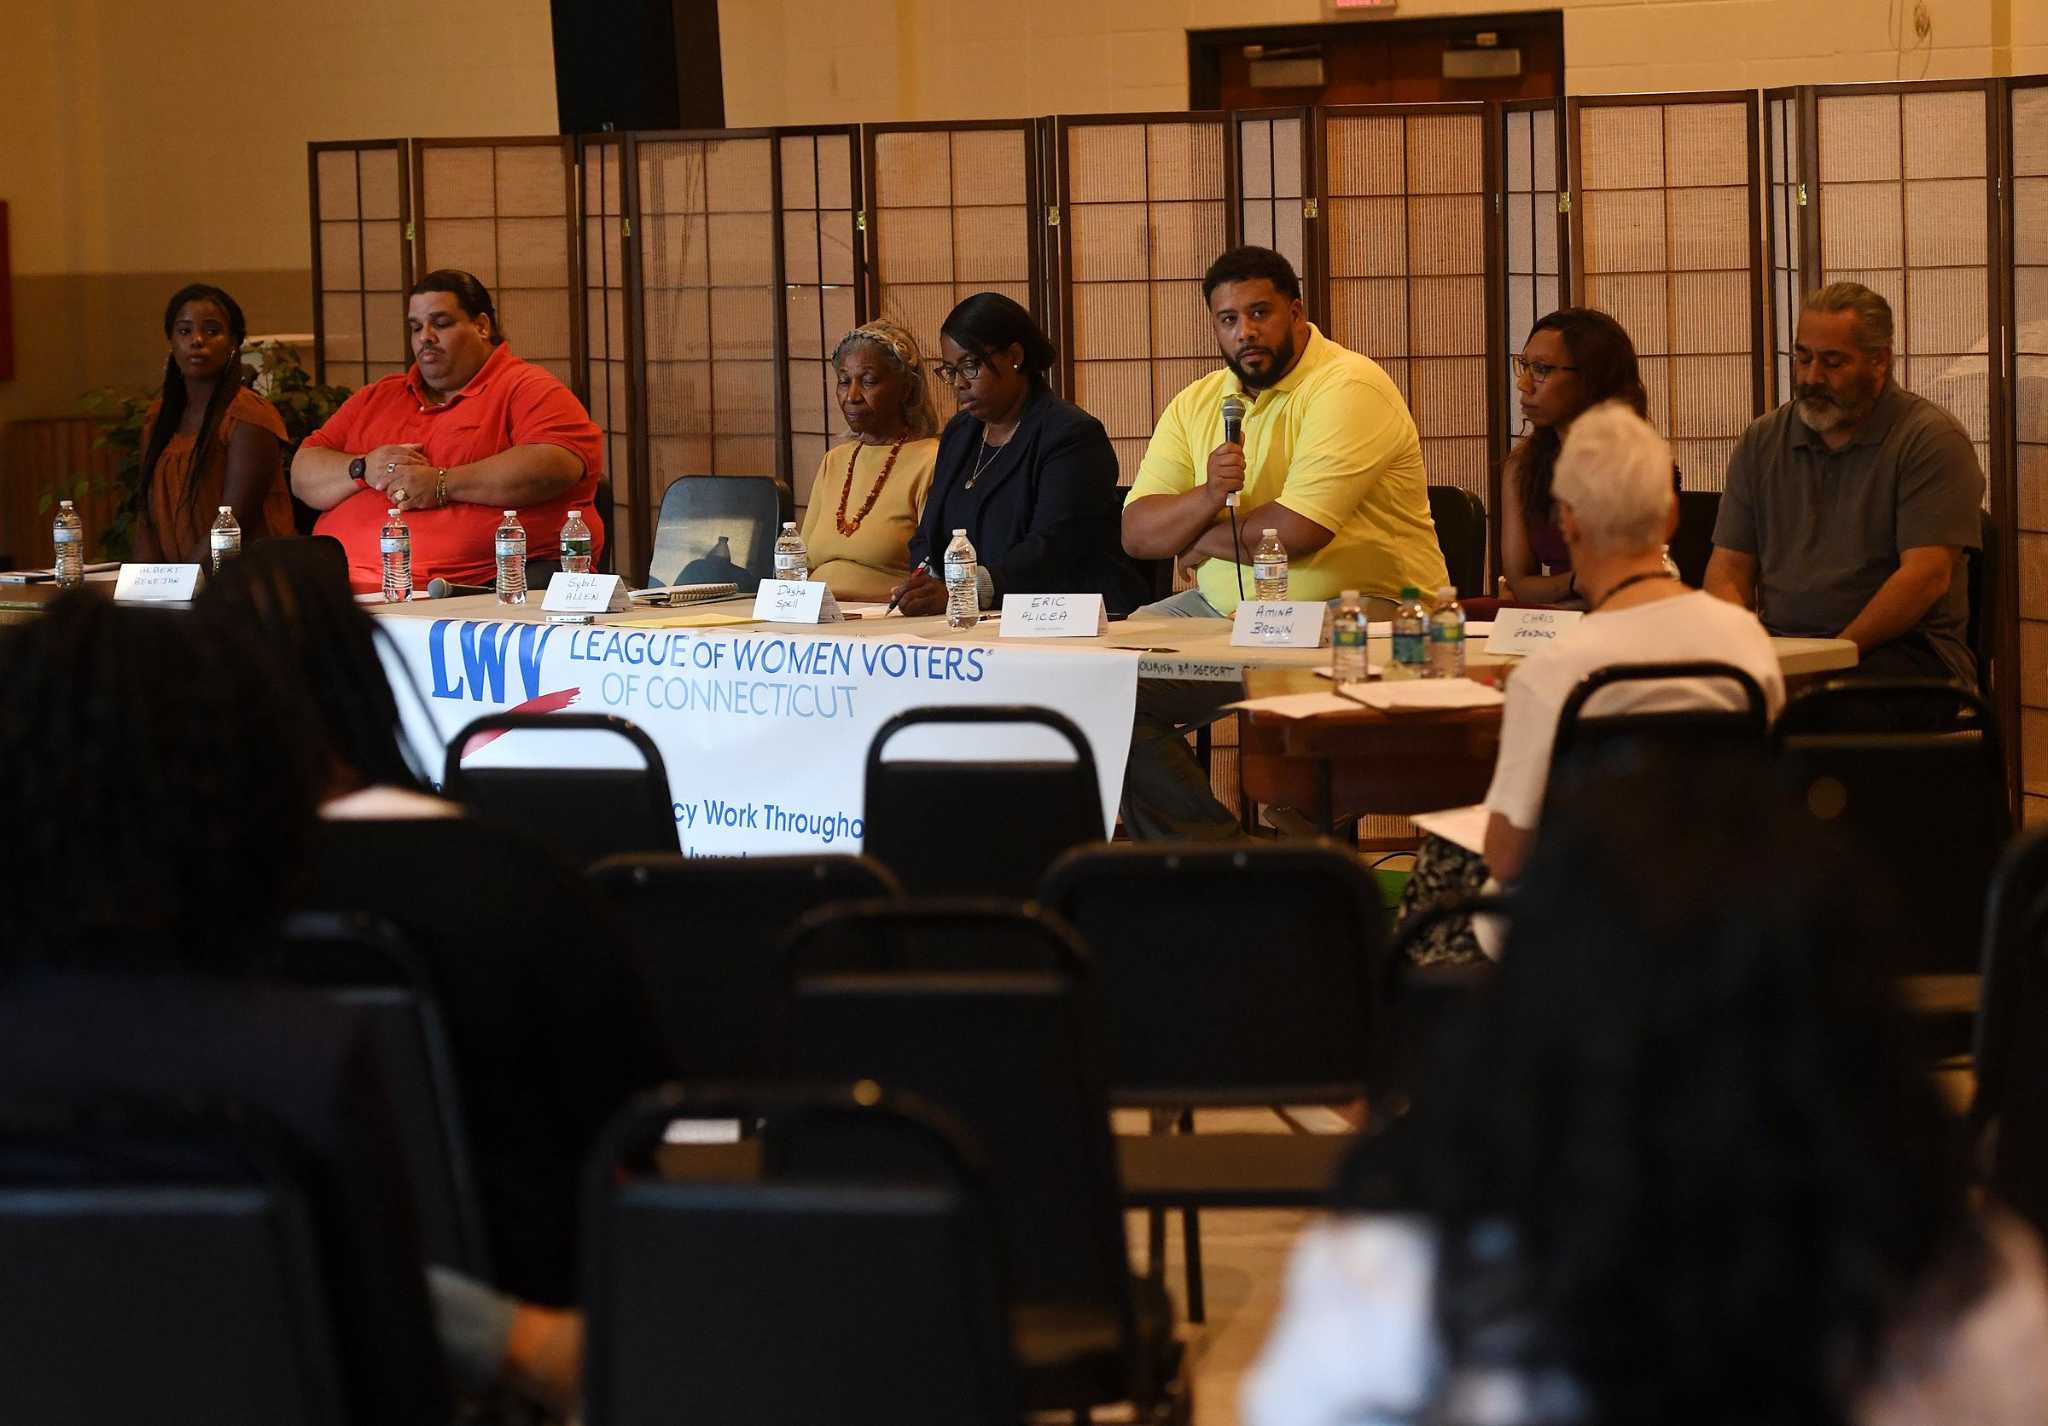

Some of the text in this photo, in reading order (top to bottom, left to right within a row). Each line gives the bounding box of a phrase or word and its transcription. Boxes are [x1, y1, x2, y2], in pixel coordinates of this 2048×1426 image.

[565, 592, 599, 601] ALLEN
[1031, 596, 1065, 608] ERIC
[1021, 611, 1068, 621] ALICEA
[1521, 613, 1555, 624] CHRIS
[1249, 621, 1295, 634] BROWN
[569, 630, 690, 668] LEAGUE
[692, 641, 727, 669] OF
[733, 638, 854, 677] WOMEN
[428, 619, 563, 704] LWV
[601, 672, 858, 719] OF CONNECTICUT
[704, 800, 758, 829] Work
